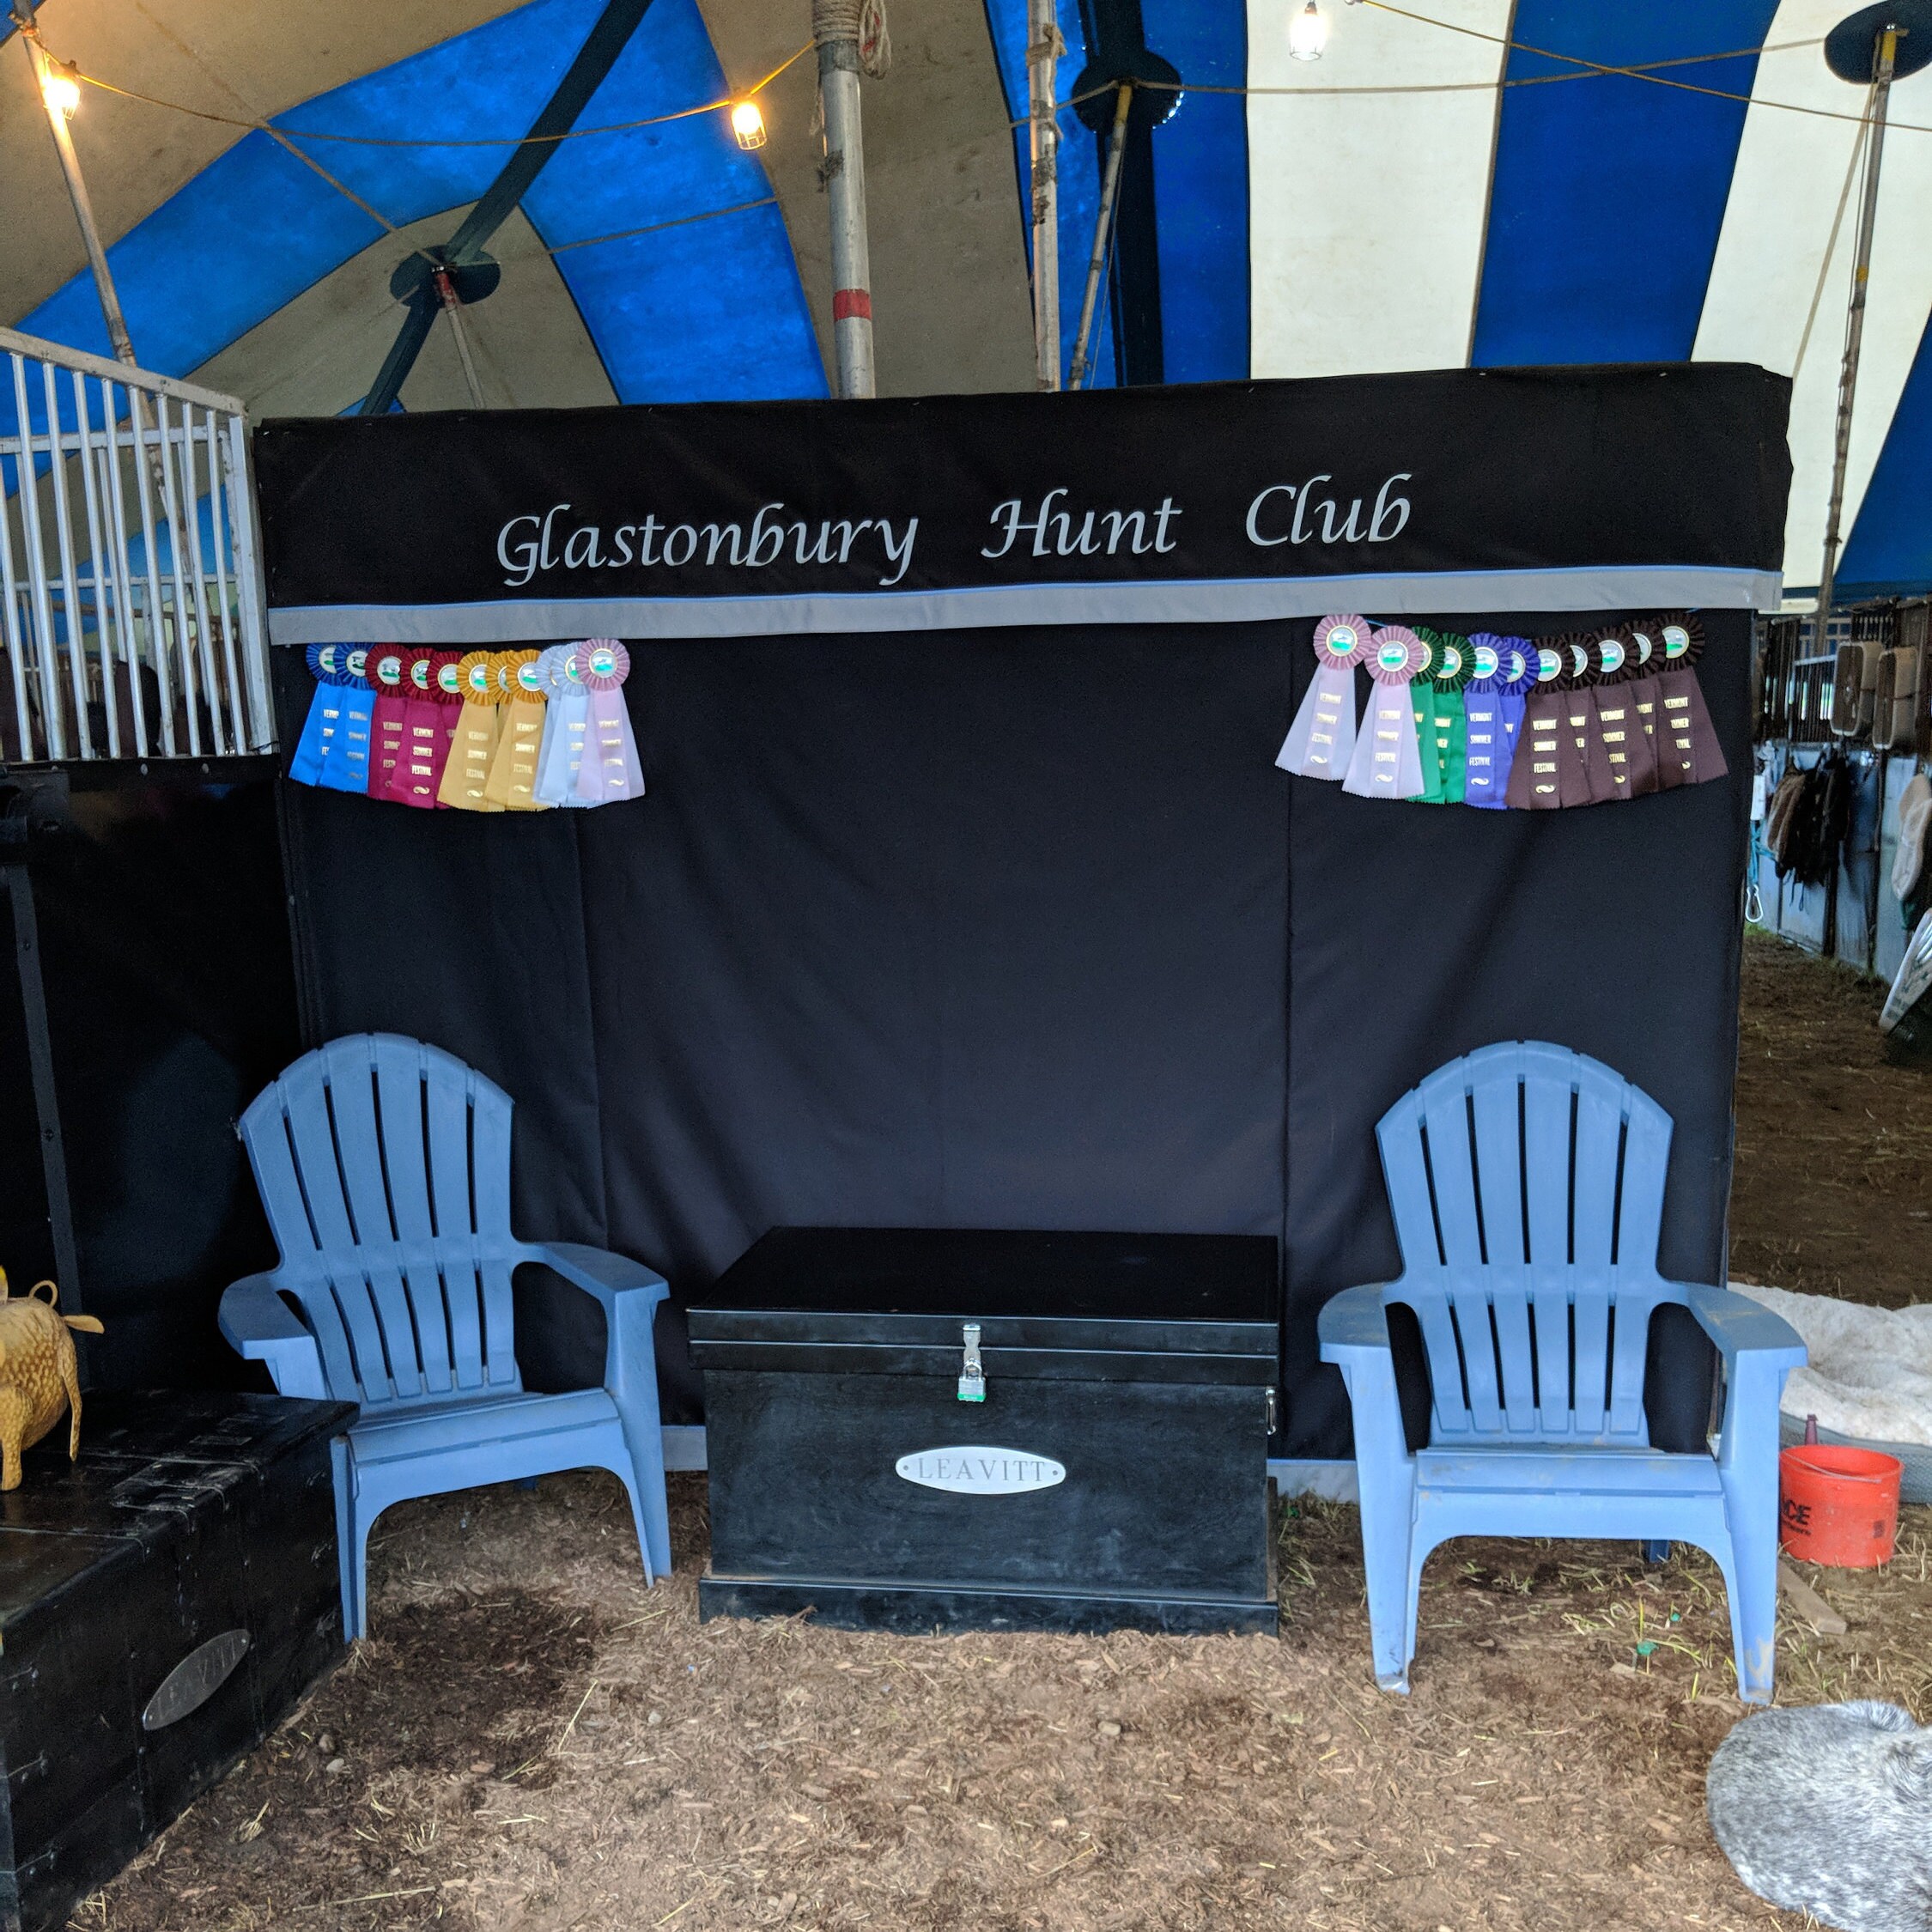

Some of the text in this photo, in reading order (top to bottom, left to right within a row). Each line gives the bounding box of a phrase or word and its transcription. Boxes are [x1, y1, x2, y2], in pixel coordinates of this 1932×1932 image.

[496, 473, 1413, 587] Glastonbury Hunt Club
[1663, 696, 1689, 709] VERMONT
[1469, 712, 1492, 722] VERMONT
[1600, 709, 1625, 721] VERMONT
[1533, 720, 1557, 731] VERMONT
[413, 727, 434, 738] VERMONT
[1602, 731, 1625, 743] SUMMER
[1469, 734, 1492, 744] SUMMER
[1675, 738, 1692, 750] TIVAL
[413, 746, 433, 757] SUMMER
[1534, 741, 1557, 751] SUMMER
[1469, 756, 1491, 767] FESTIVAL
[1608, 752, 1626, 763] STIVAL
[412, 765, 432, 776] FESTIVAL
[1534, 762, 1556, 774] FESTIVAL
[918, 1457, 1045, 1482] LEAVITT
[1782, 1498, 1812, 1526] CE
